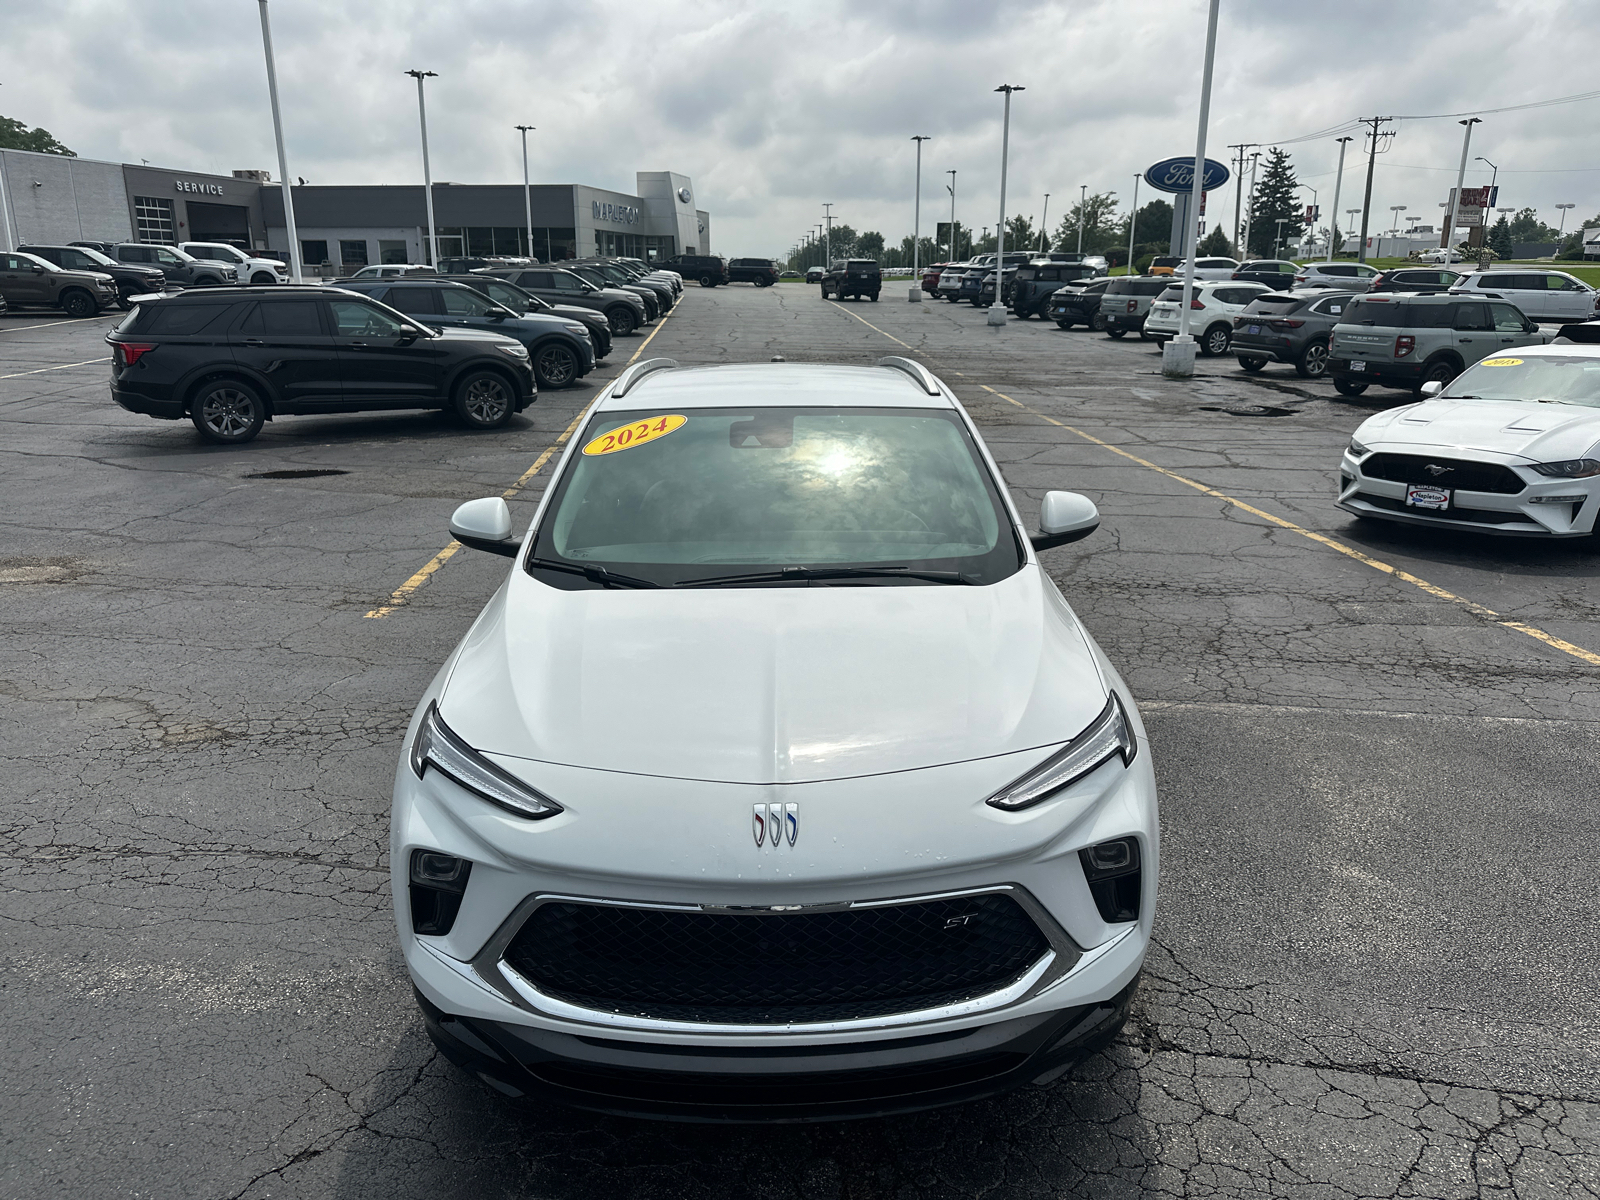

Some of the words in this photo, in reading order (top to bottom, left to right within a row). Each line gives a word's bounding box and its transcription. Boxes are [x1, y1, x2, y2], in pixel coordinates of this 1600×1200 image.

[176, 180, 224, 196] SERVICE
[592, 200, 640, 225] NAPLETON
[600, 417, 668, 453] 2024
[1415, 492, 1442, 501] Napleton
[944, 912, 979, 930] ST
